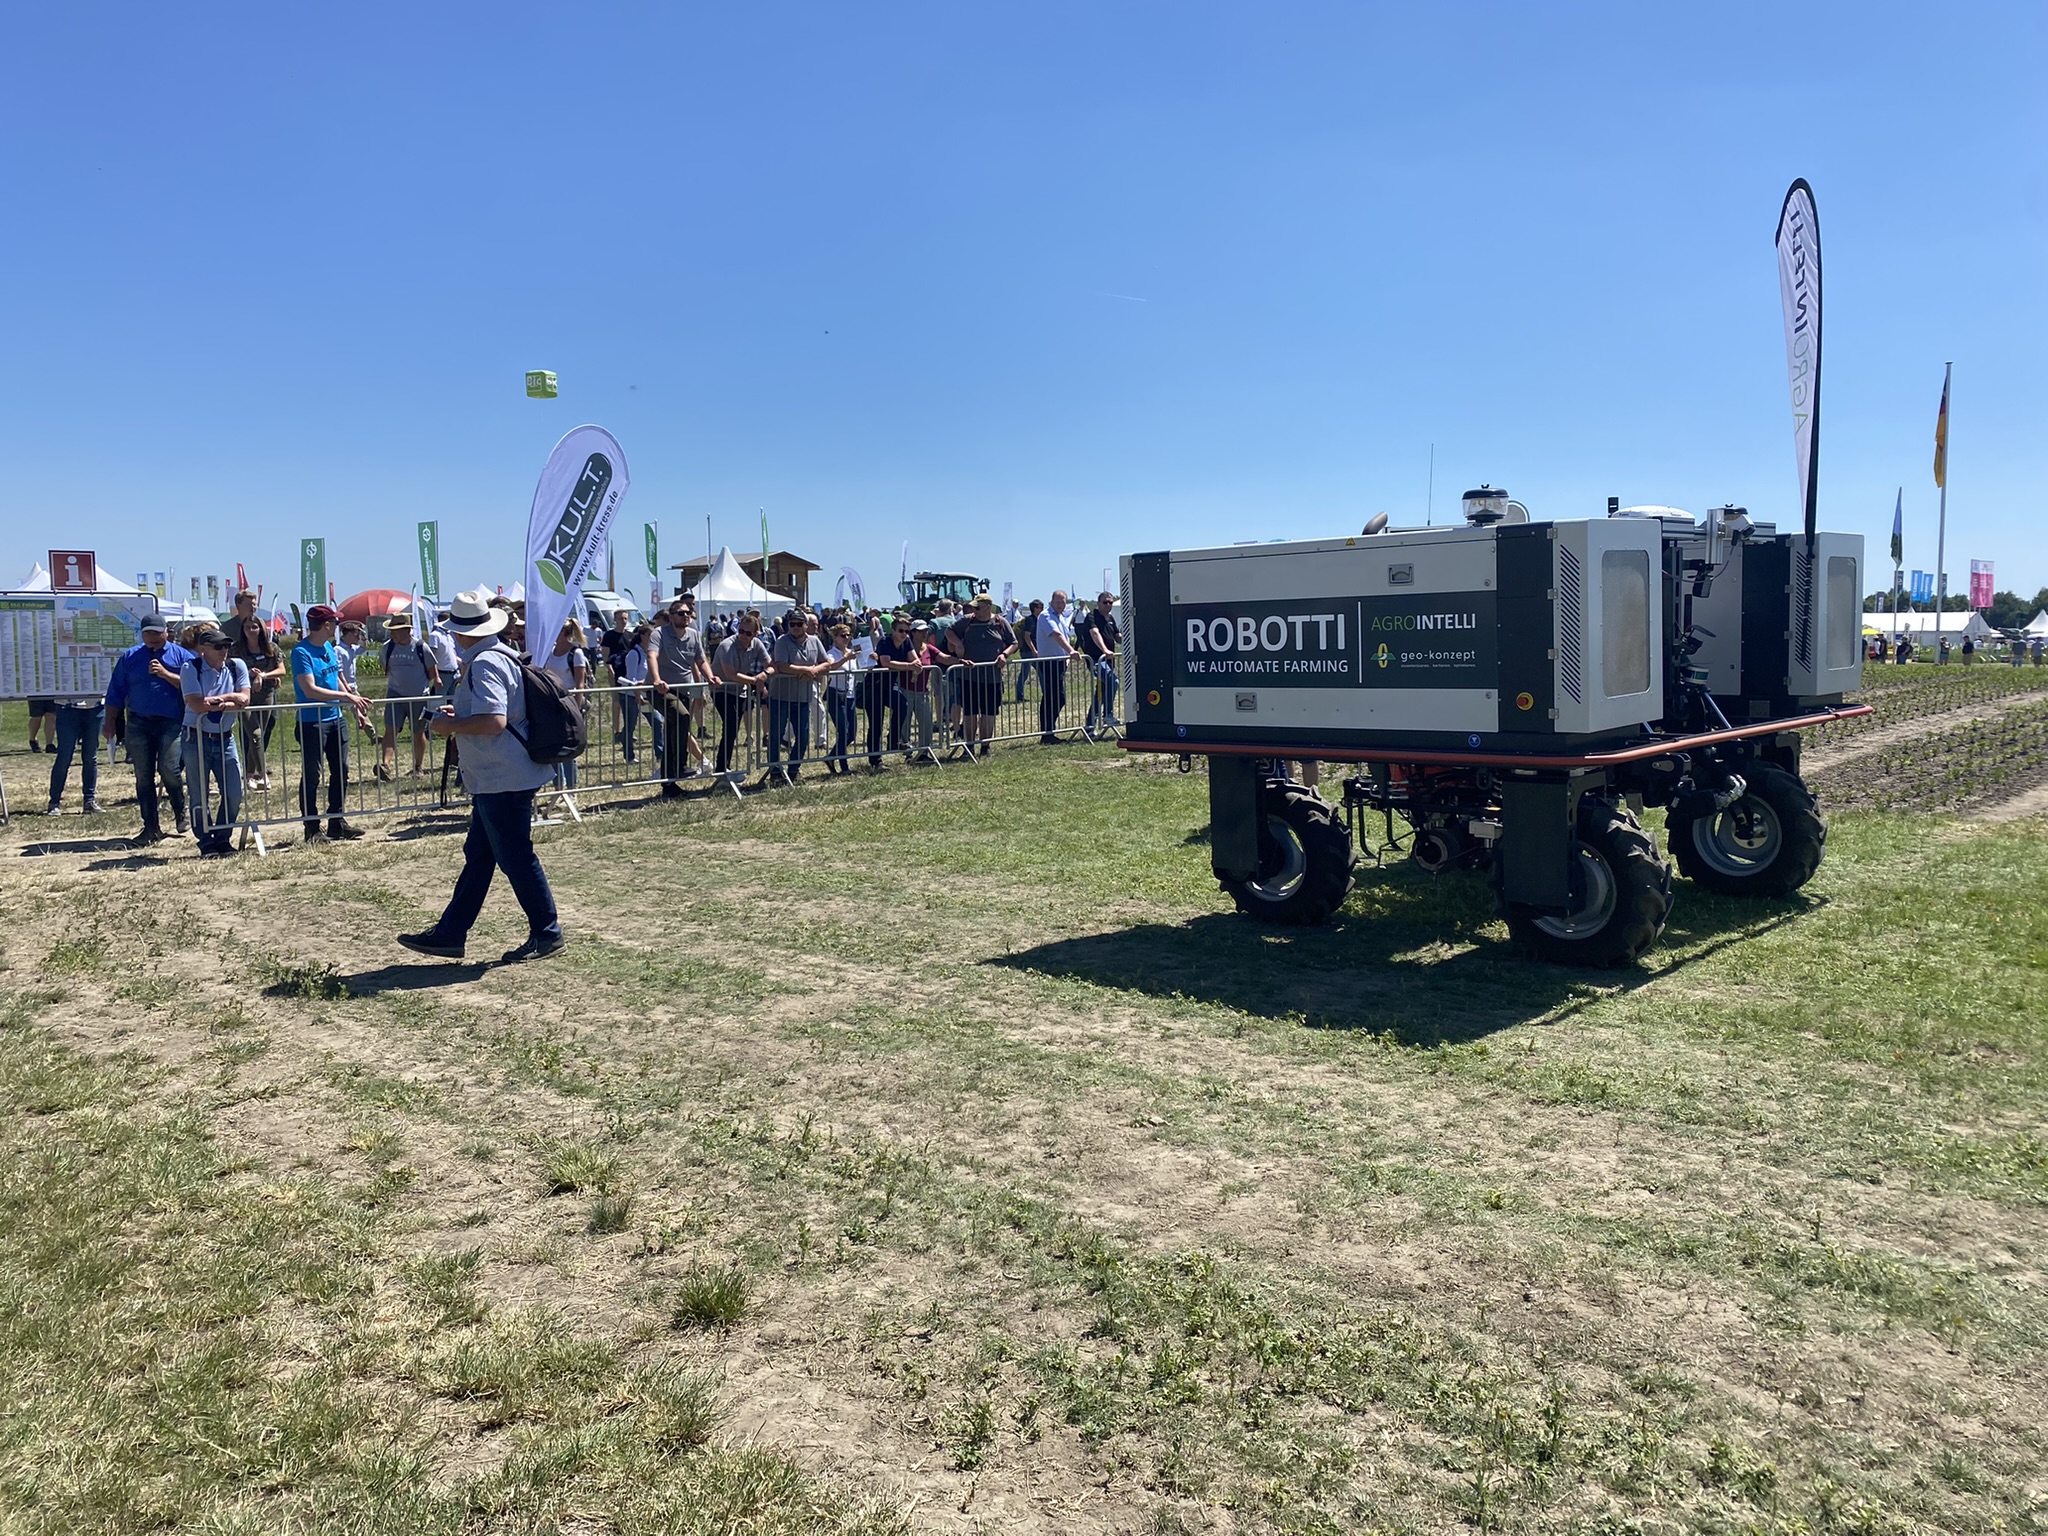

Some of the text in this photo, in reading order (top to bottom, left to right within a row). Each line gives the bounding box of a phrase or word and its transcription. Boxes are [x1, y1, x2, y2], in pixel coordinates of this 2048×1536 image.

[549, 461, 604, 563] K.U.L.T.
[573, 490, 618, 587] www.kult-kress.de
[1187, 614, 1345, 652] ROBOTTI
[1371, 613, 1476, 631] AGROINTELLI
[1187, 660, 1349, 673] WE AUTOMATE FARMING
[1401, 650, 1476, 662] geo-konzept
